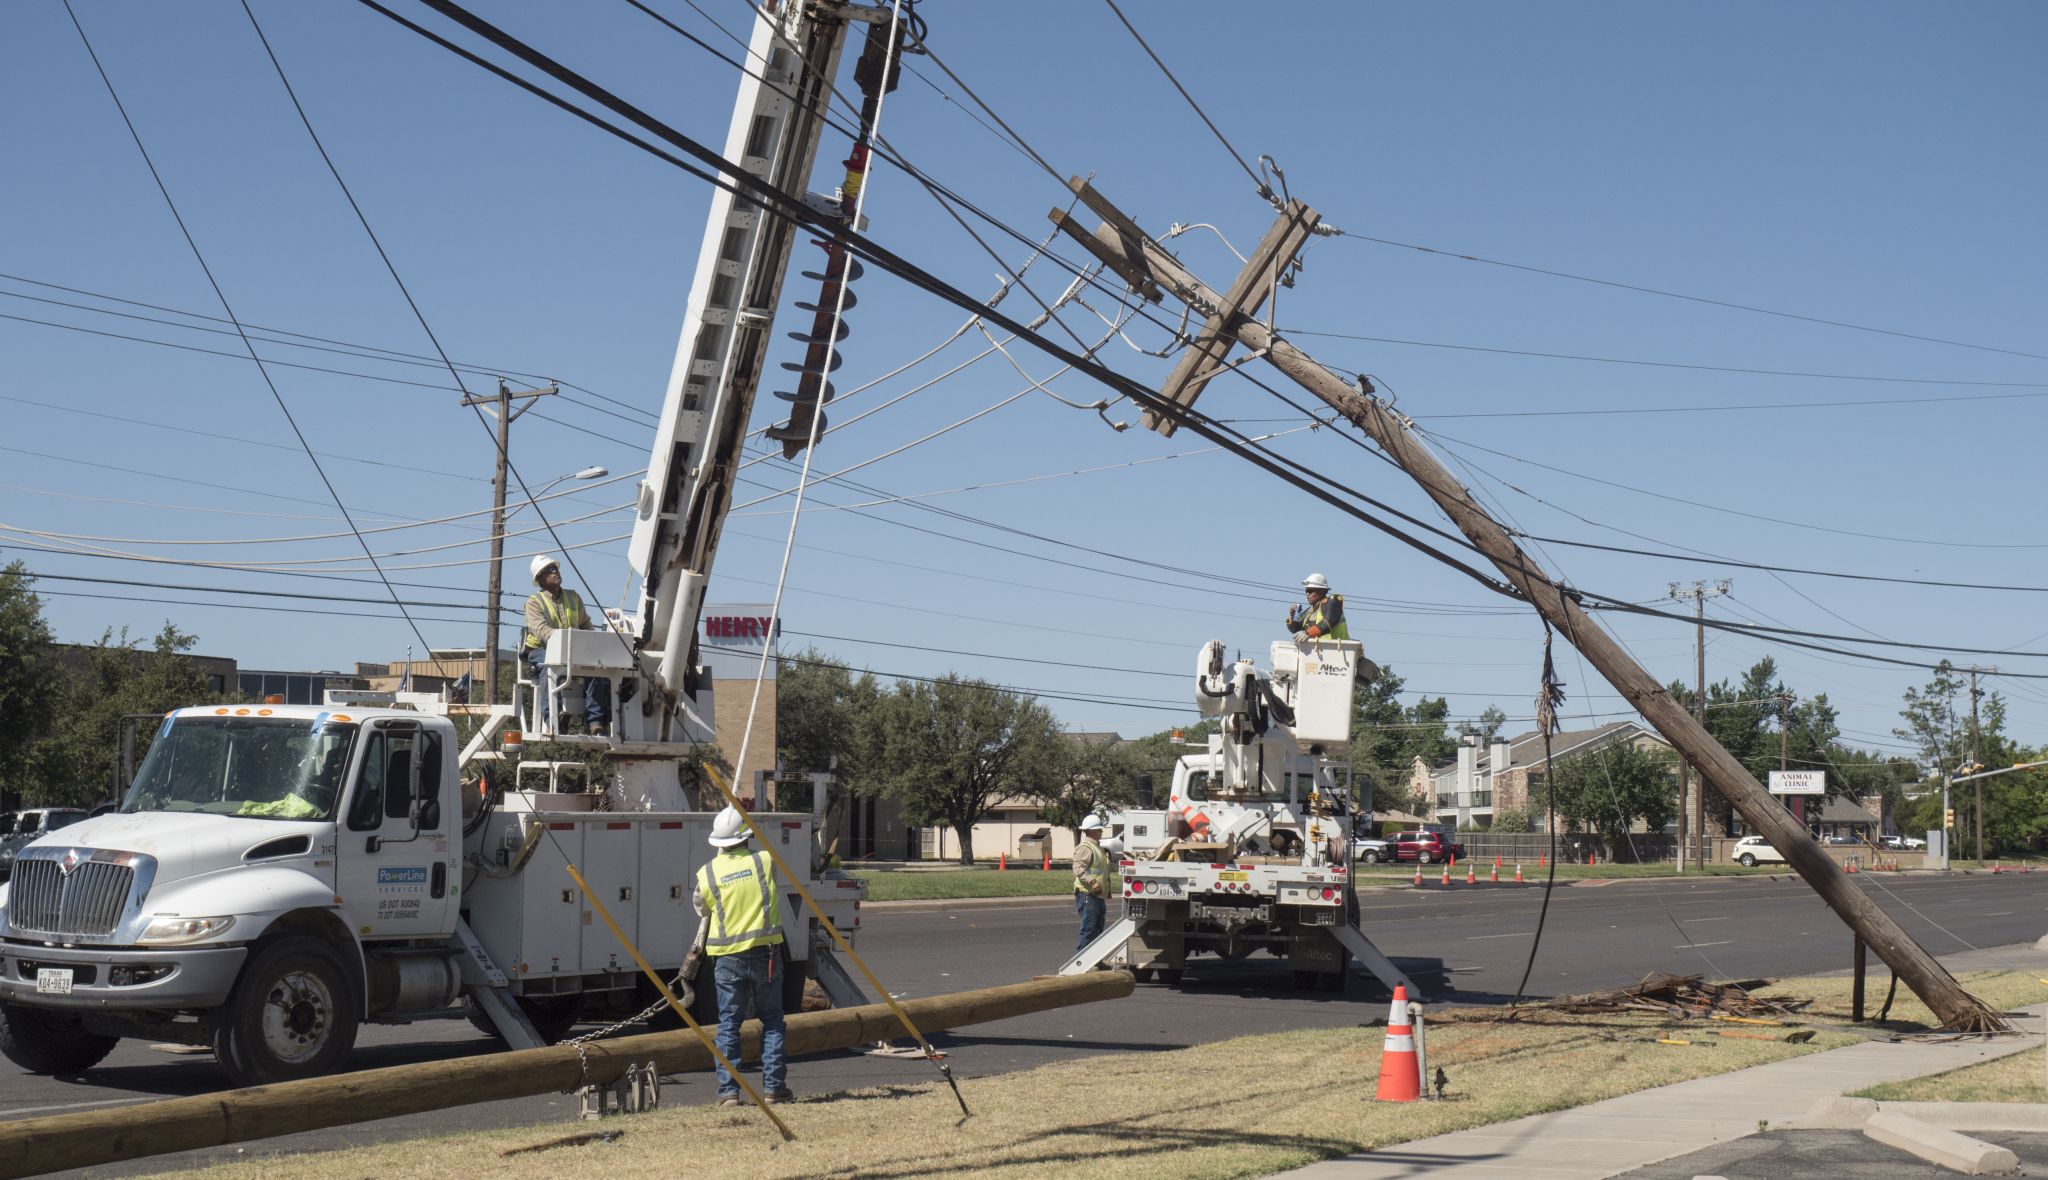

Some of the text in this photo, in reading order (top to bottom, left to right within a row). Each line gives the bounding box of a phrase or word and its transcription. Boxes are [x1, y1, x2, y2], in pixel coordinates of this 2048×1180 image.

[706, 617, 774, 637] HENRY
[1319, 663, 1348, 676] Altec
[380, 869, 425, 881] PowerLine
[379, 899, 387, 909] US
[388, 899, 400, 909] DOT
